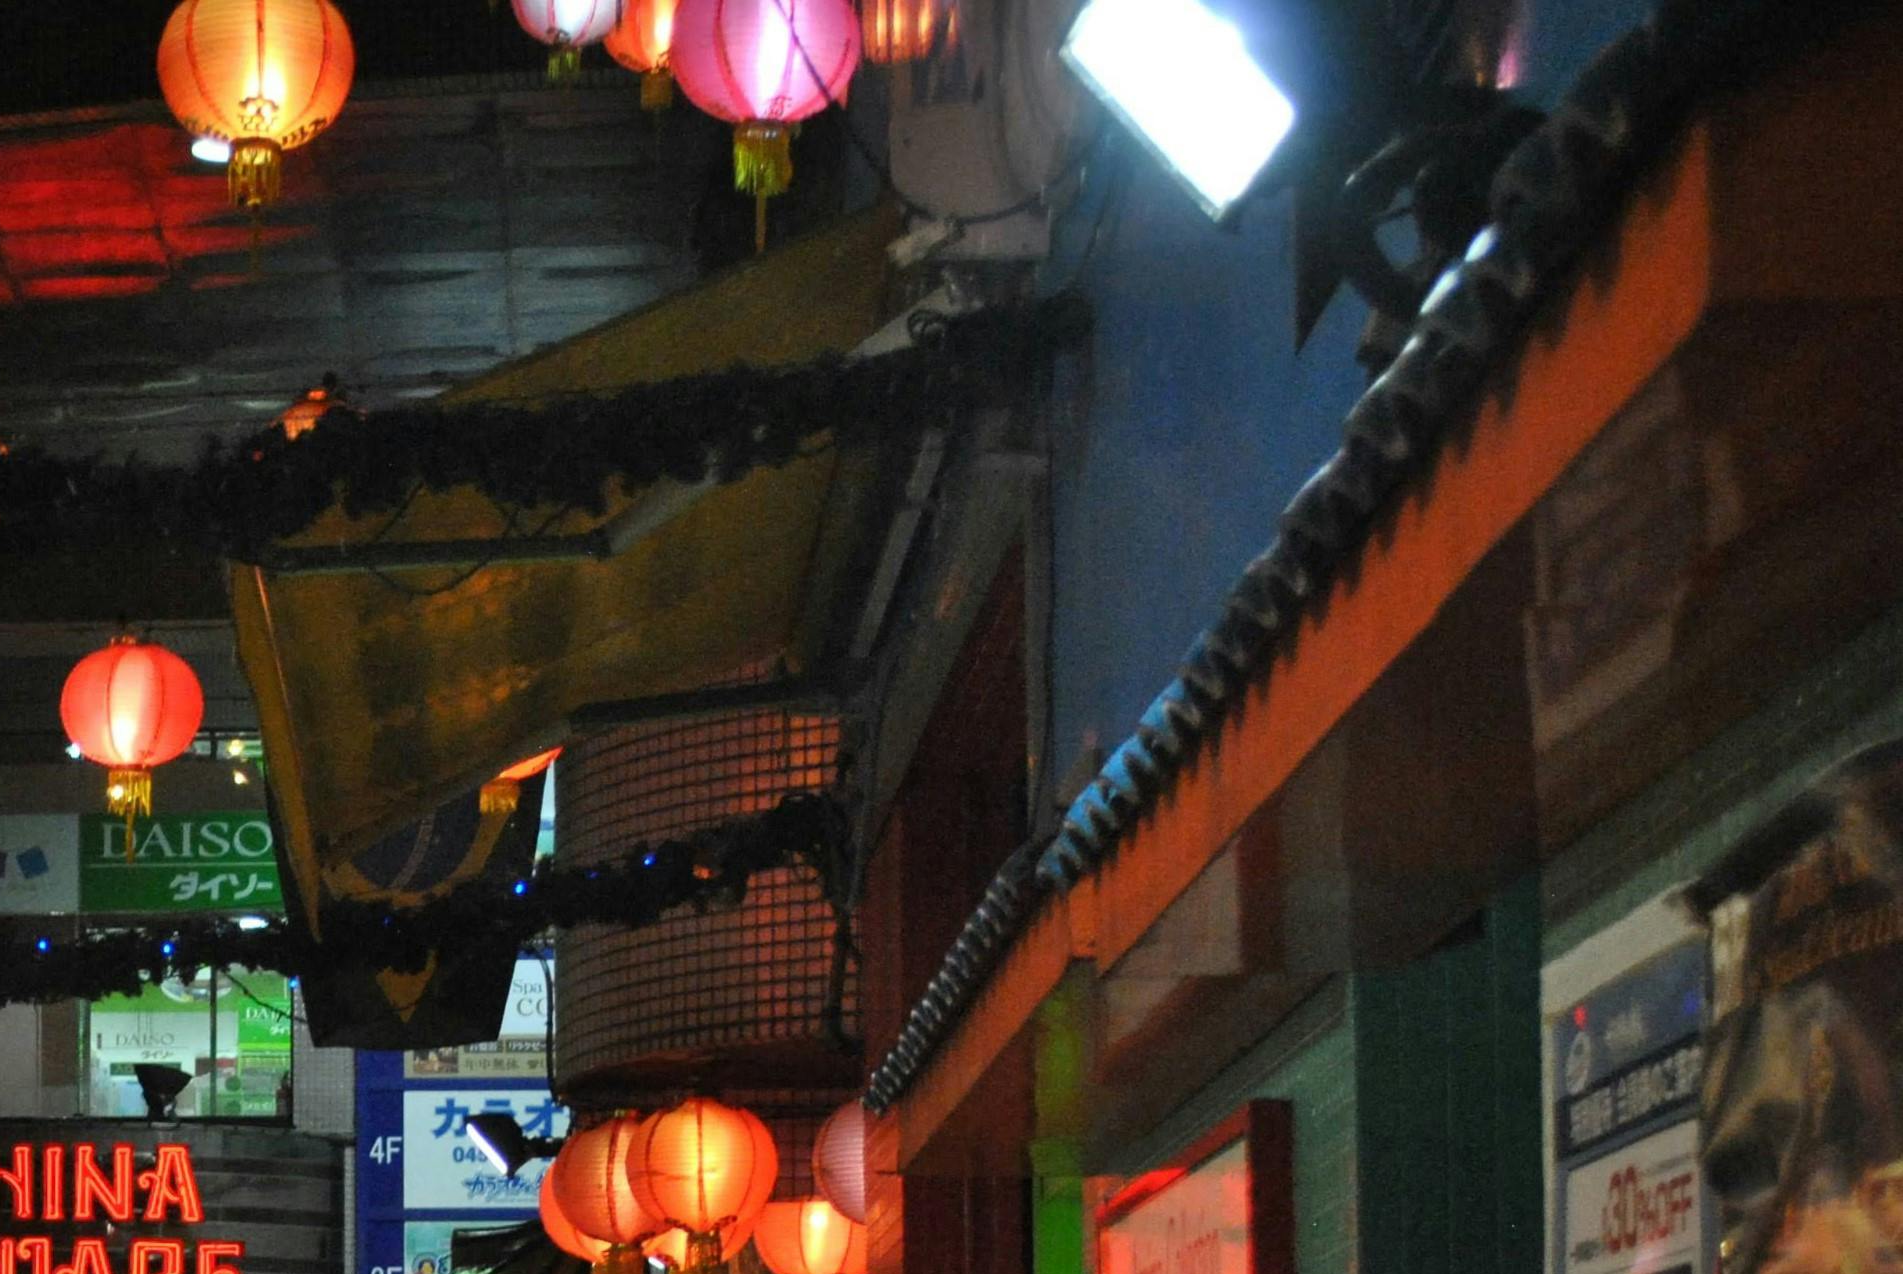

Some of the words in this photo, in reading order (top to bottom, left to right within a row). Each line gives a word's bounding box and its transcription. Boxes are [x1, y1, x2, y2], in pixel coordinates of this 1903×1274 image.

[101, 820, 274, 858] DAISO
[168, 870, 274, 901] ダイソー
[512, 979, 543, 995] Spa
[115, 1032, 175, 1047] DAISO
[368, 1136, 402, 1164] 4F
